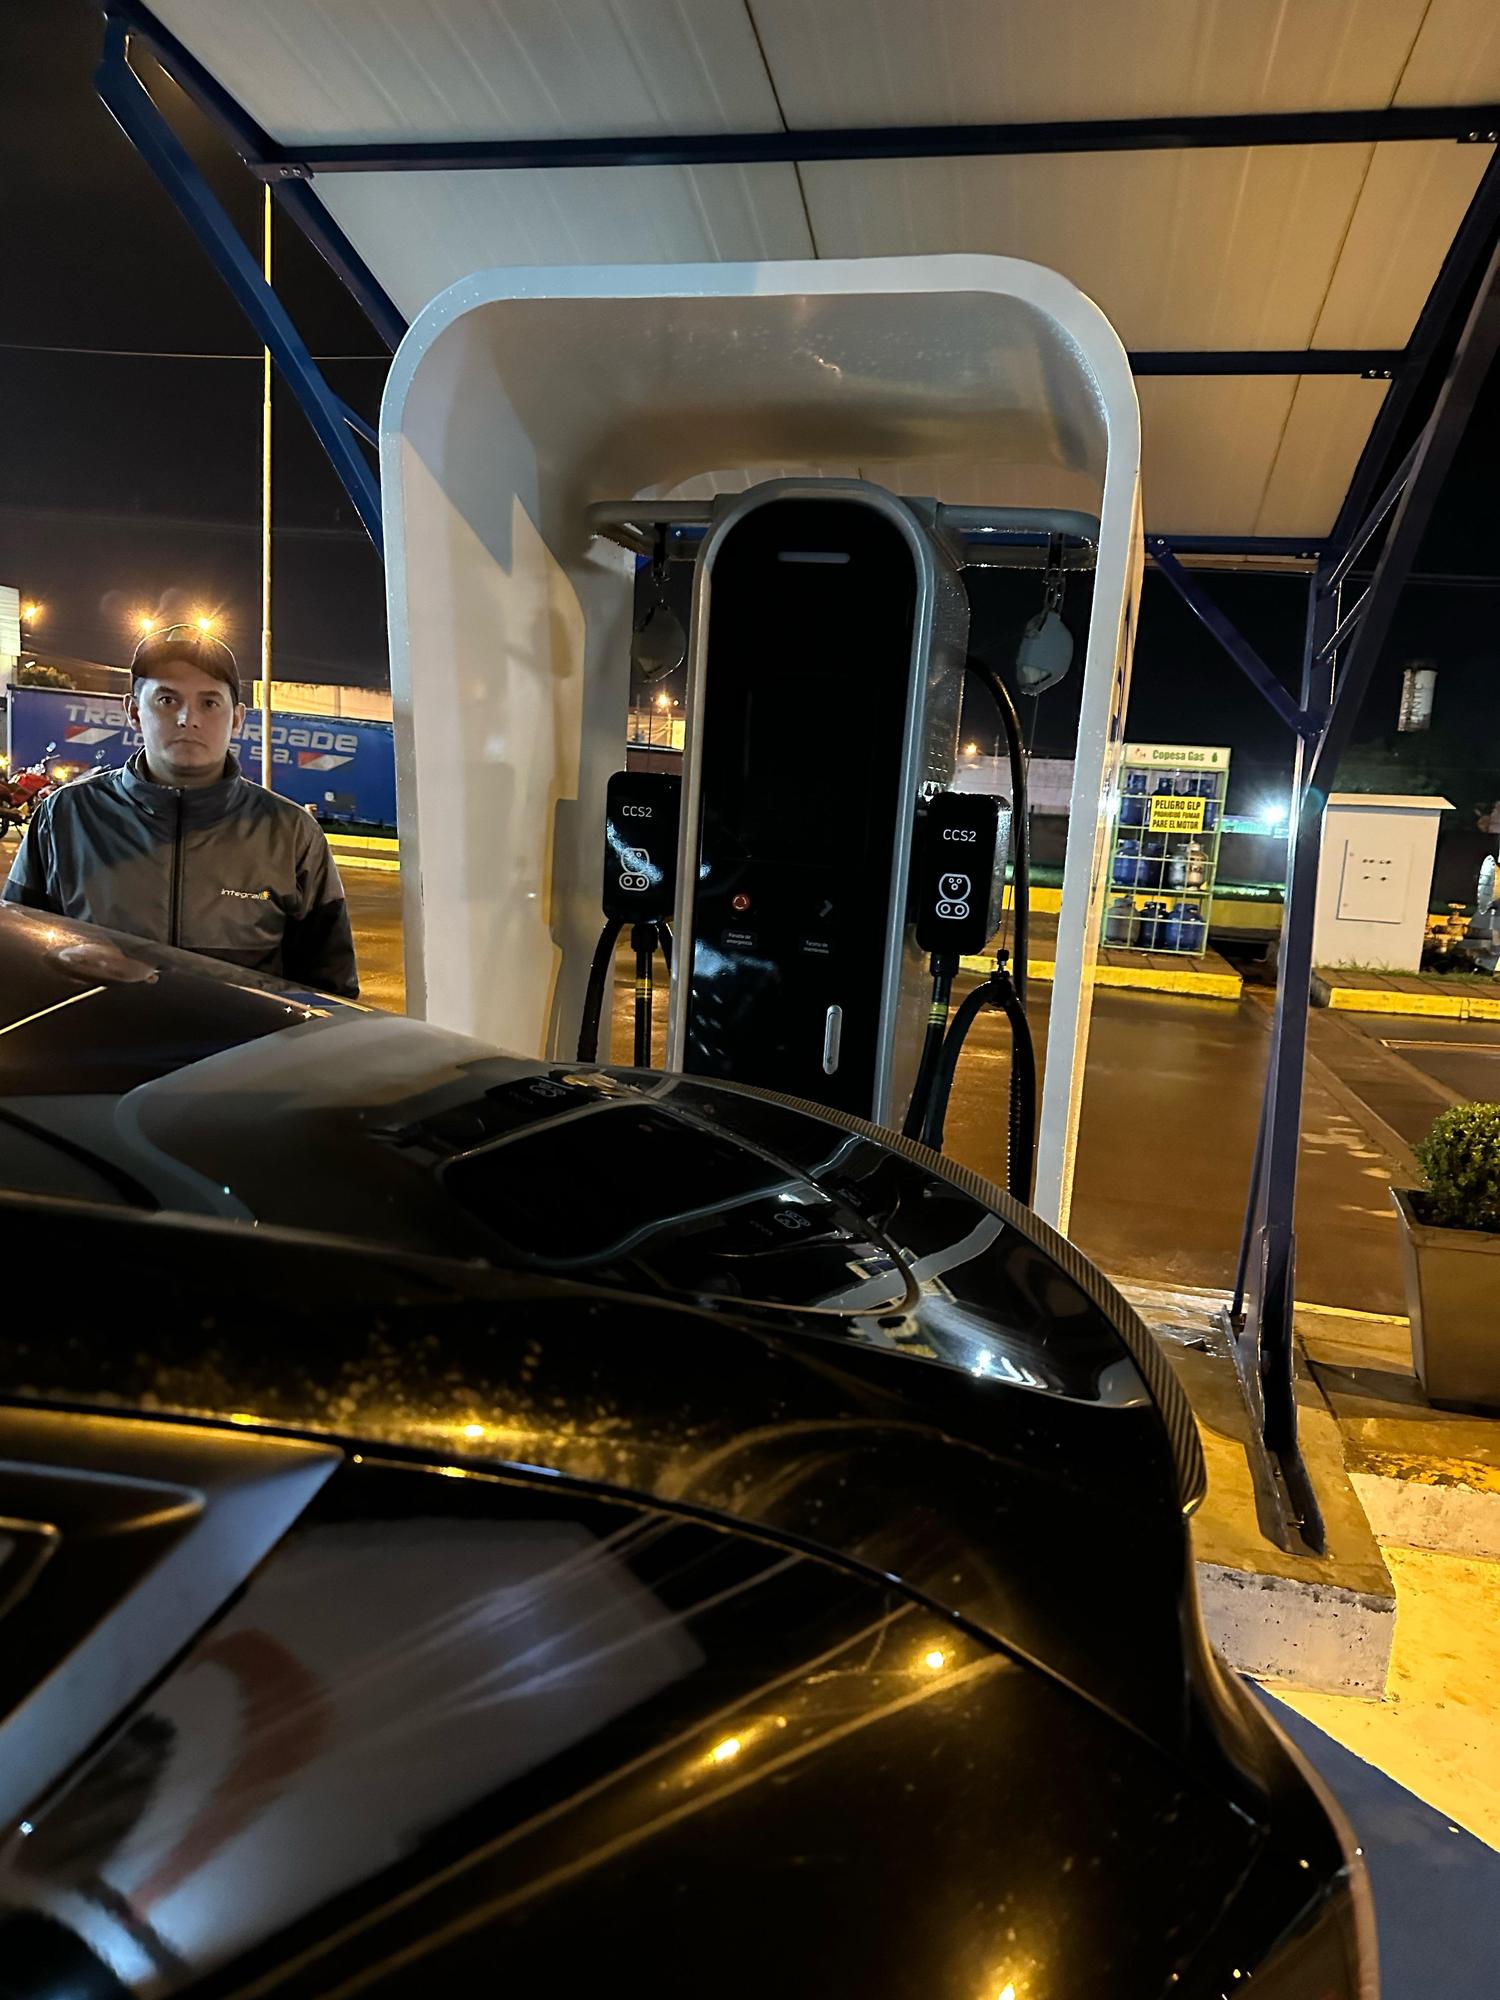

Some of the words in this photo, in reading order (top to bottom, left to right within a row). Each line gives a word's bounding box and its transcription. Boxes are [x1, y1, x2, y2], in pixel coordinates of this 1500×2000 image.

[1152, 749, 1186, 761] Copesa
[1187, 751, 1205, 761] Gas
[1155, 799, 1185, 810] PELIGRO
[1187, 801, 1201, 811] GLP
[622, 805, 653, 818] CCS2
[1152, 819, 1168, 828] PARE
[1169, 820, 1176, 829] EL
[1176, 821, 1199, 830] MOTOR
[942, 828, 977, 842] CCS2
